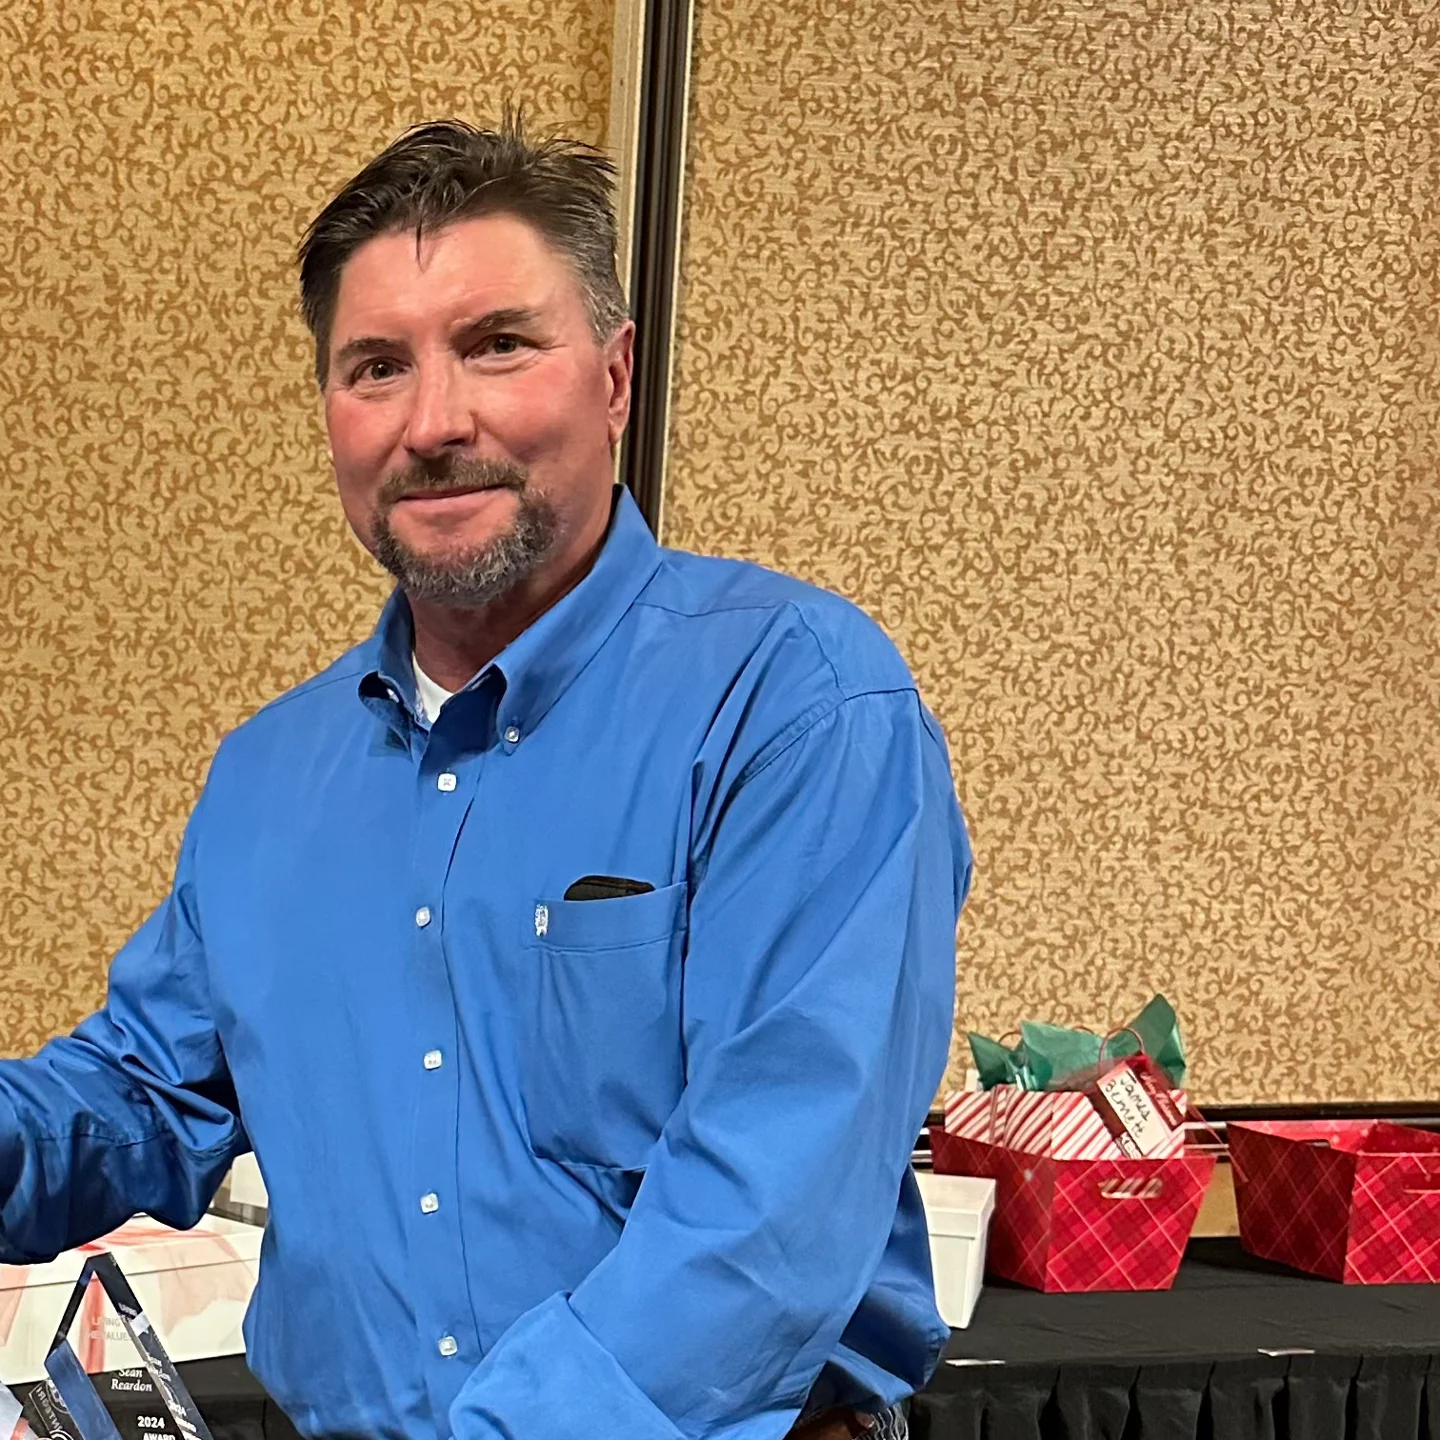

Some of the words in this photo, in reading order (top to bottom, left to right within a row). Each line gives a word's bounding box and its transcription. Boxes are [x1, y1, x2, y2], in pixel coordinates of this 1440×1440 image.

[1120, 1070, 1151, 1122] James
[118, 1366, 143, 1378] Sean
[111, 1379, 153, 1392] Reardon
[137, 1416, 165, 1429] 2024
